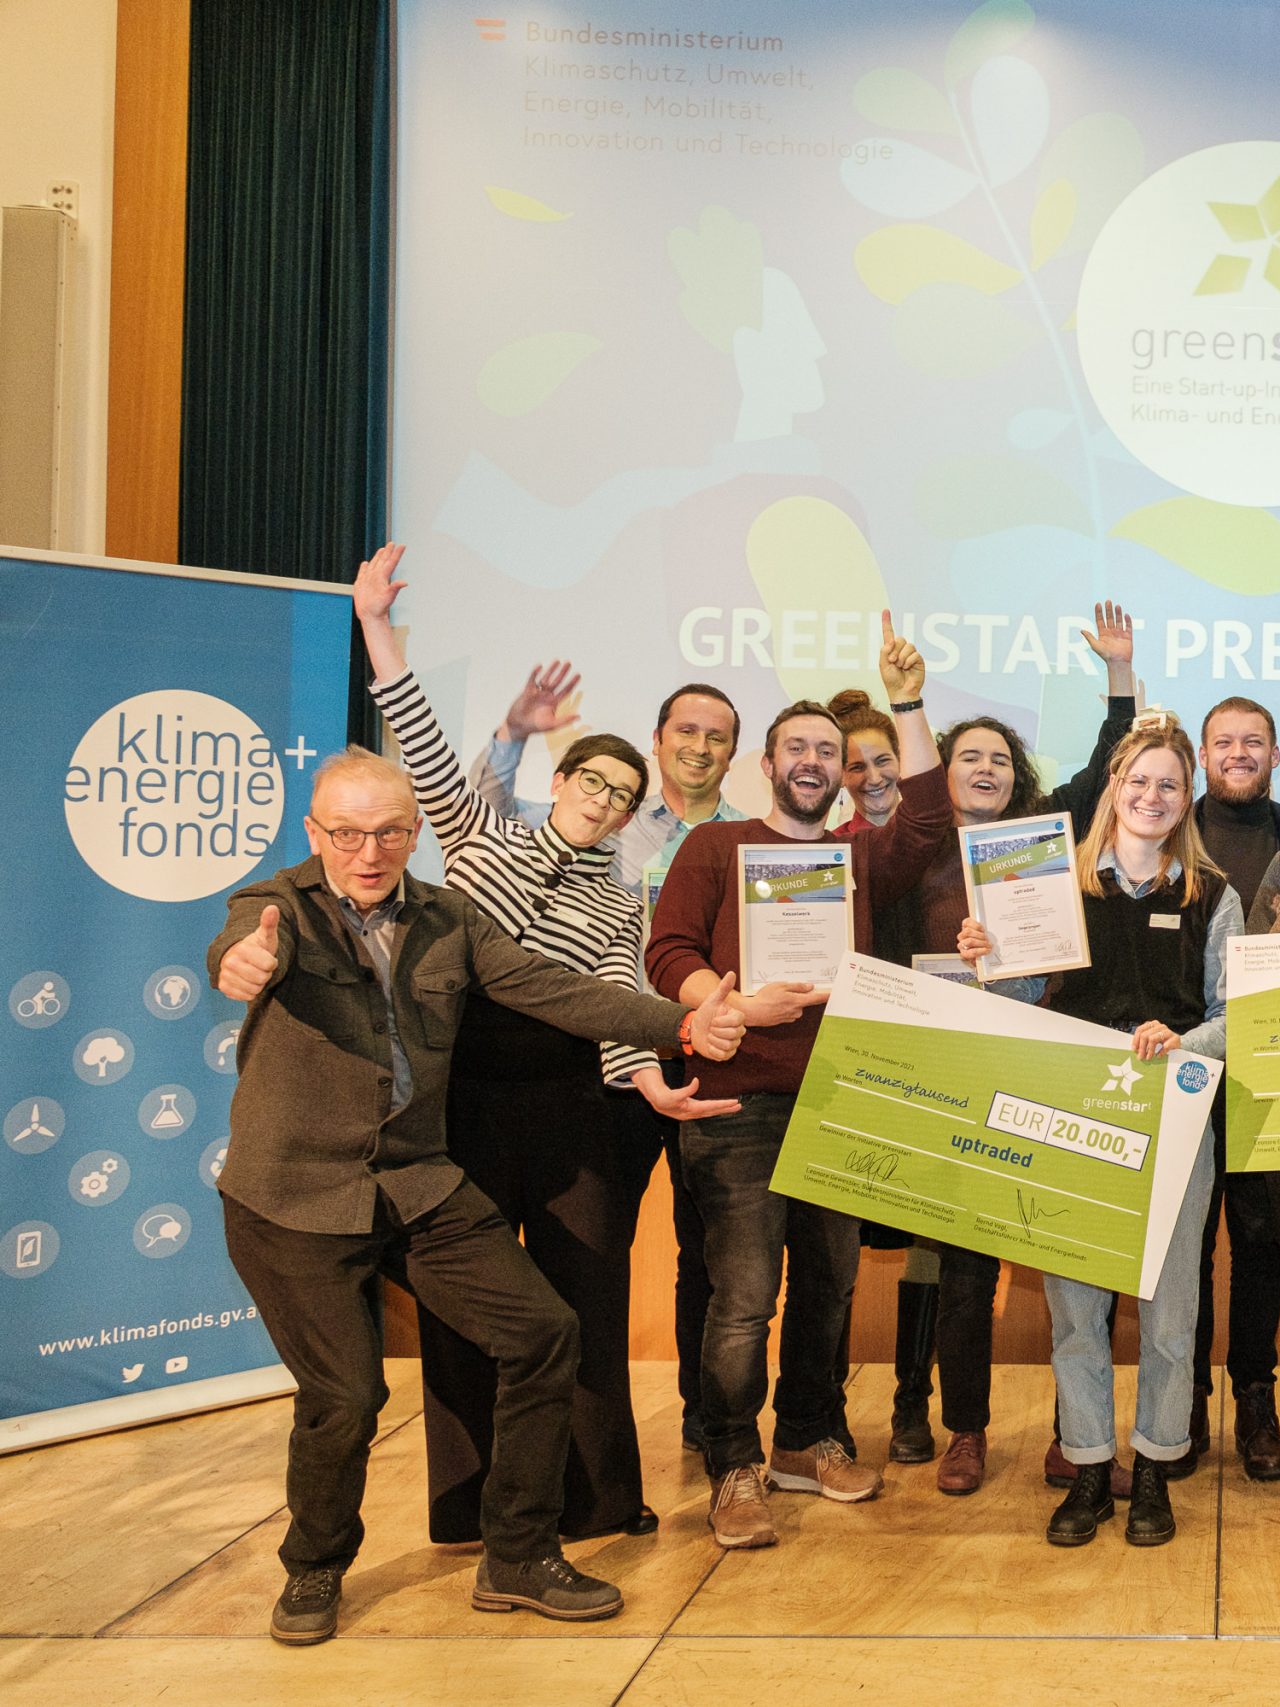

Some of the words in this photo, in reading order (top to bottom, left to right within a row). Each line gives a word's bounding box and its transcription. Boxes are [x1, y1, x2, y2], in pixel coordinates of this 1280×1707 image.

[525, 21, 784, 53] Bundesministerium
[523, 56, 694, 87] Klimaschutz,
[706, 64, 815, 92] Umwelt,
[523, 91, 632, 121] Energie,
[643, 94, 773, 126] Mobilität,
[523, 128, 664, 154] Innovation
[675, 133, 723, 155] und
[735, 134, 893, 165] Technologie
[1132, 376, 1172, 395] Eine
[1131, 404, 1198, 423] Klima-
[1207, 408, 1243, 425] und
[679, 605, 1144, 676] GREESTAR
[117, 712, 276, 768] klima
[64, 766, 274, 820] energie
[119, 806, 272, 857] fonds
[989, 853, 1033, 873] URKUNDE
[770, 879, 808, 892] RKUNDE
[855, 1068, 969, 1108] zwanzigtausend
[998, 1103, 1045, 1132] EUR
[1052, 1119, 1142, 1161] 20.000,-
[951, 1134, 1033, 1168] uptraded
